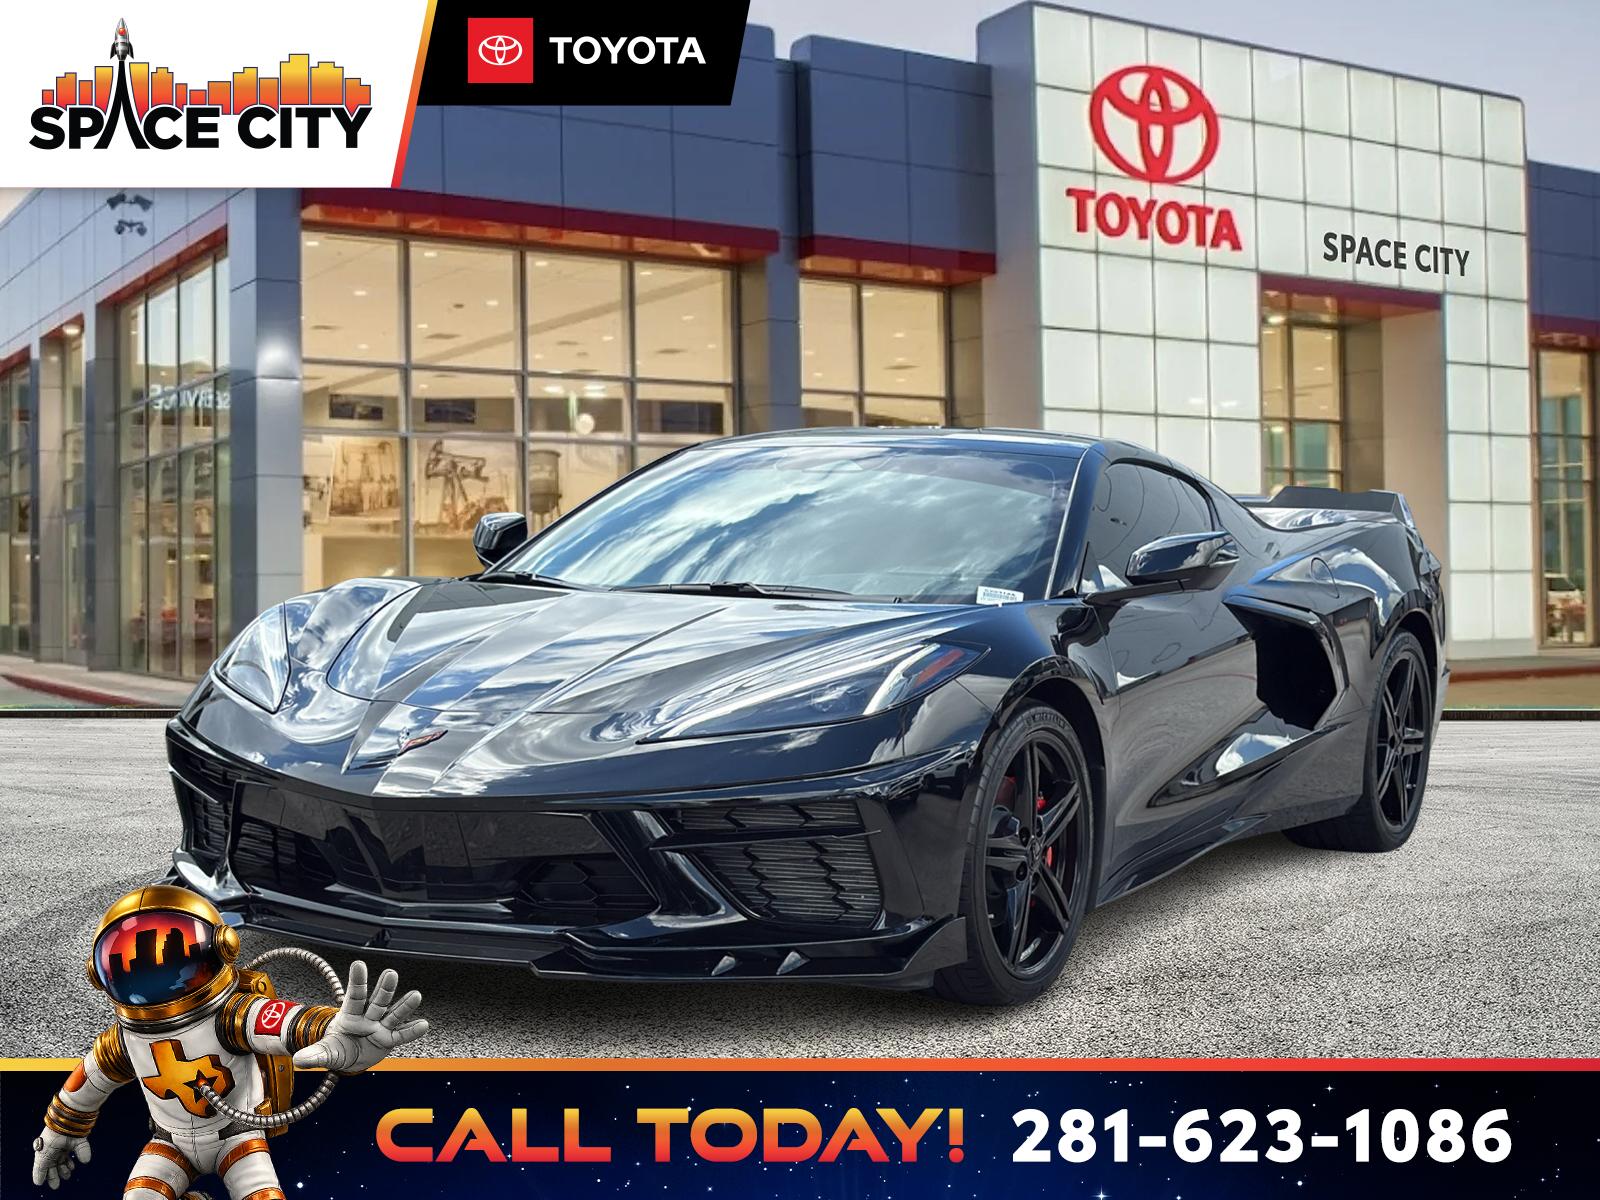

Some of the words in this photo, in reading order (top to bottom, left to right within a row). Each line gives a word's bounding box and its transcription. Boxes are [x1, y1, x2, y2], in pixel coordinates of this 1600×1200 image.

[1066, 187, 1243, 251] TOYOTA
[1322, 231, 1407, 270] SPACE
[1414, 244, 1471, 277] CITY
